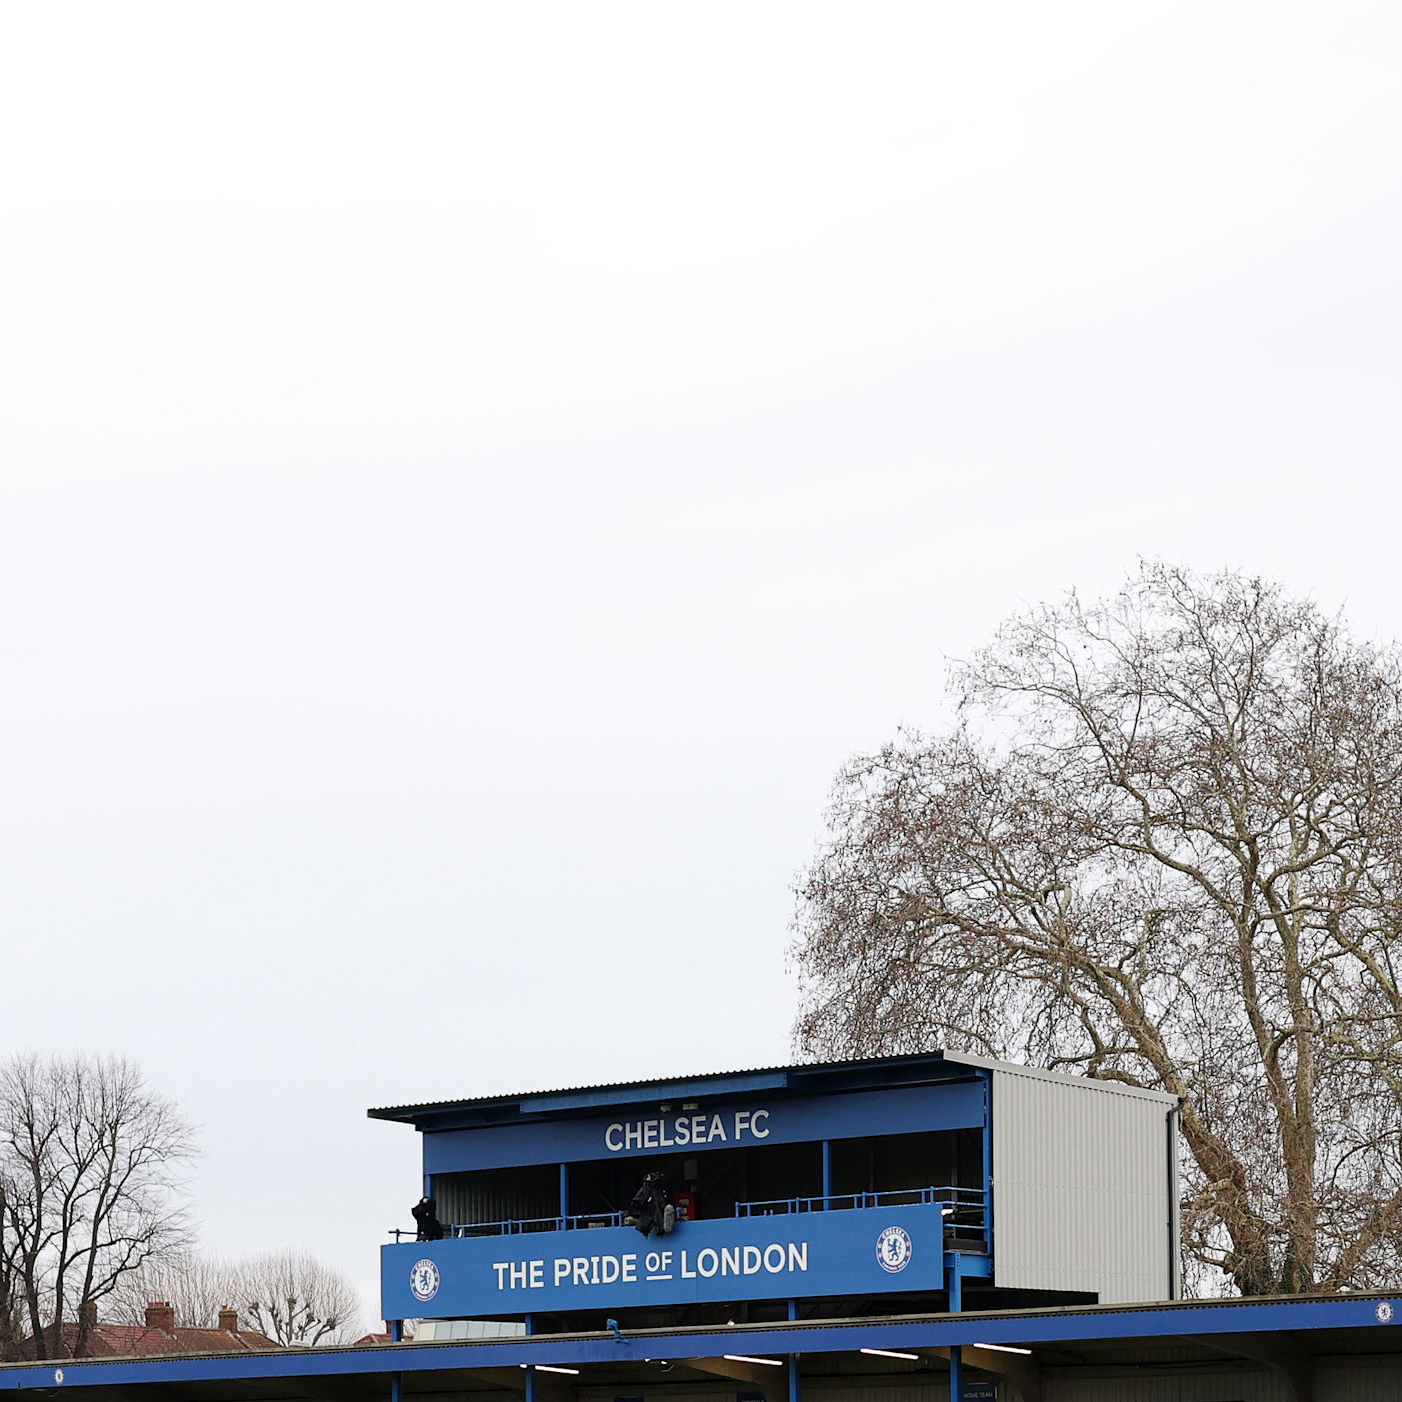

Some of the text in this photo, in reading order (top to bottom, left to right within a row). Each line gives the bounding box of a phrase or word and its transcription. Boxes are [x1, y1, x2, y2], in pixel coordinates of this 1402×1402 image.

[605, 1109, 770, 1151] CHELSEA FC
[492, 1242, 808, 1290] THE PRIDE OF LONDON
